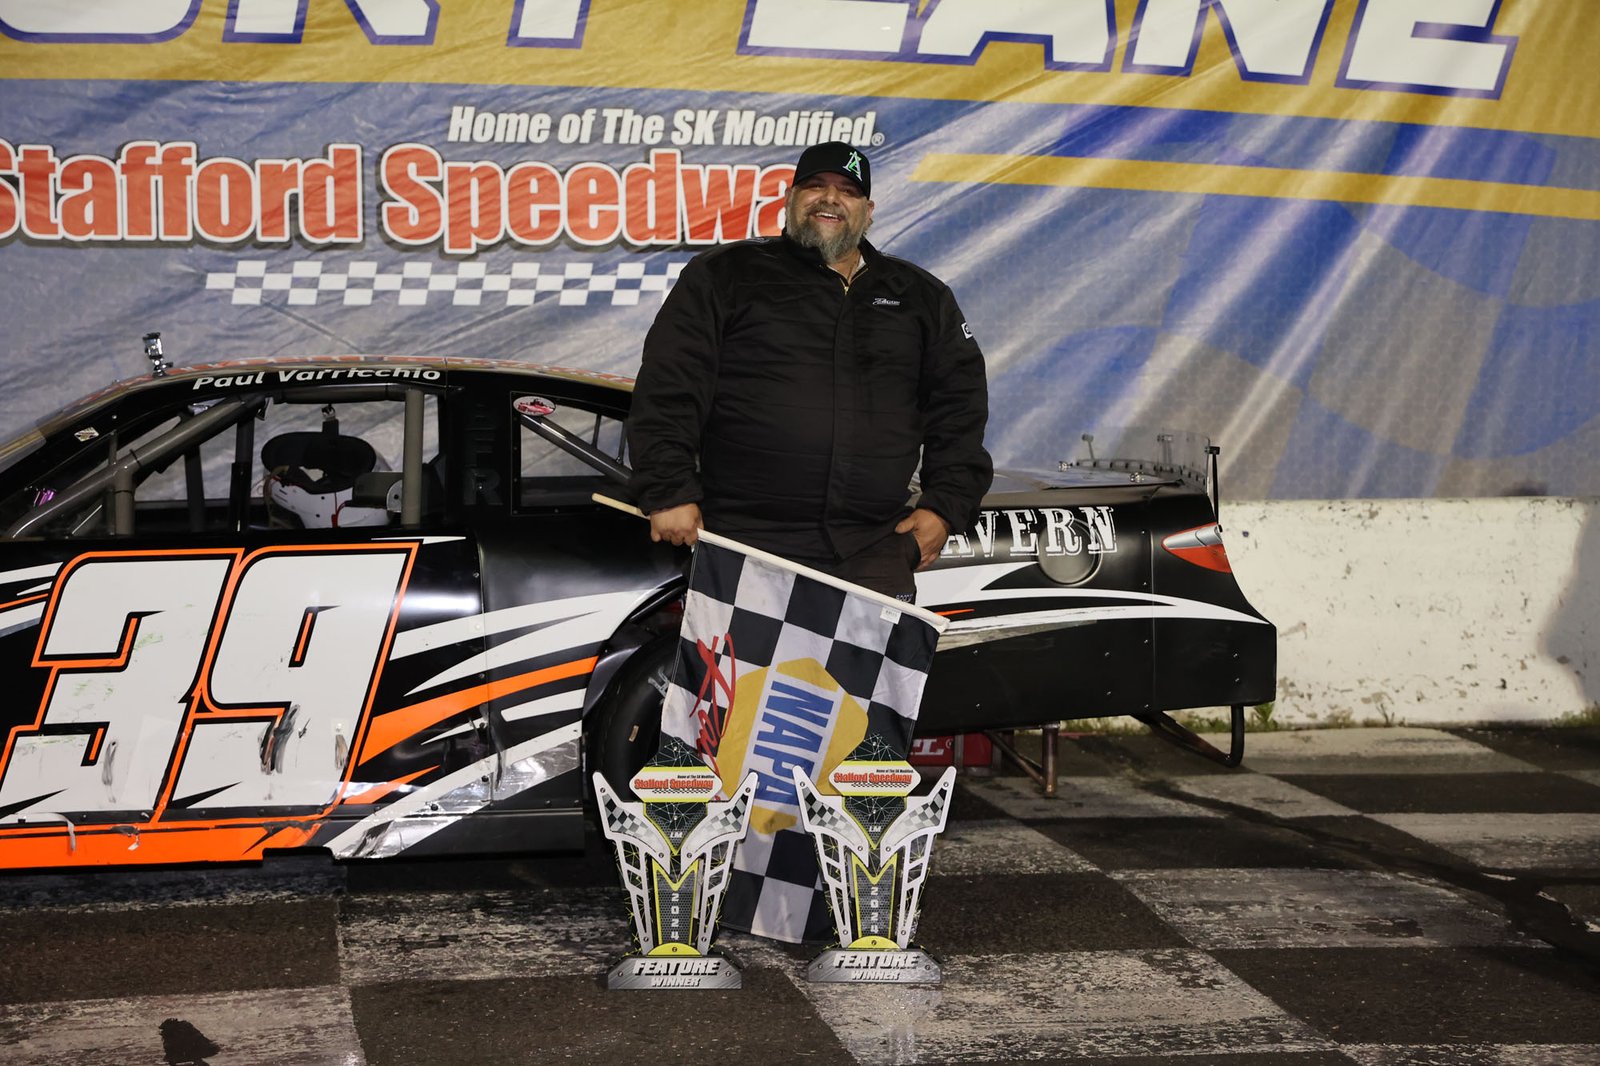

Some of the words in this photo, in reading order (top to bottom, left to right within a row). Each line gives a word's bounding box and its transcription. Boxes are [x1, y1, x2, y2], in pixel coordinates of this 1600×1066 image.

[447, 106, 551, 143] Home
[558, 107, 595, 144] of
[602, 108, 665, 145] The
[670, 109, 725, 145] SK
[192, 371, 266, 390] Paul
[940, 506, 1118, 558] AVERN
[0, 545, 419, 825] 39
[749, 680, 834, 806] NAPA
[634, 779, 669, 790] Stafford
[670, 778, 714, 791] Speedway
[834, 772, 868, 784] Stafford
[869, 772, 912, 785] Speedway
[669, 831, 683, 839] LM
[869, 825, 882, 833] LM
[671, 892, 680, 941] 2024
[632, 958, 720, 977] FEATURE
[832, 953, 919, 970] FEATURE
[651, 977, 701, 989] WINNER
[851, 970, 900, 982] WINNER
